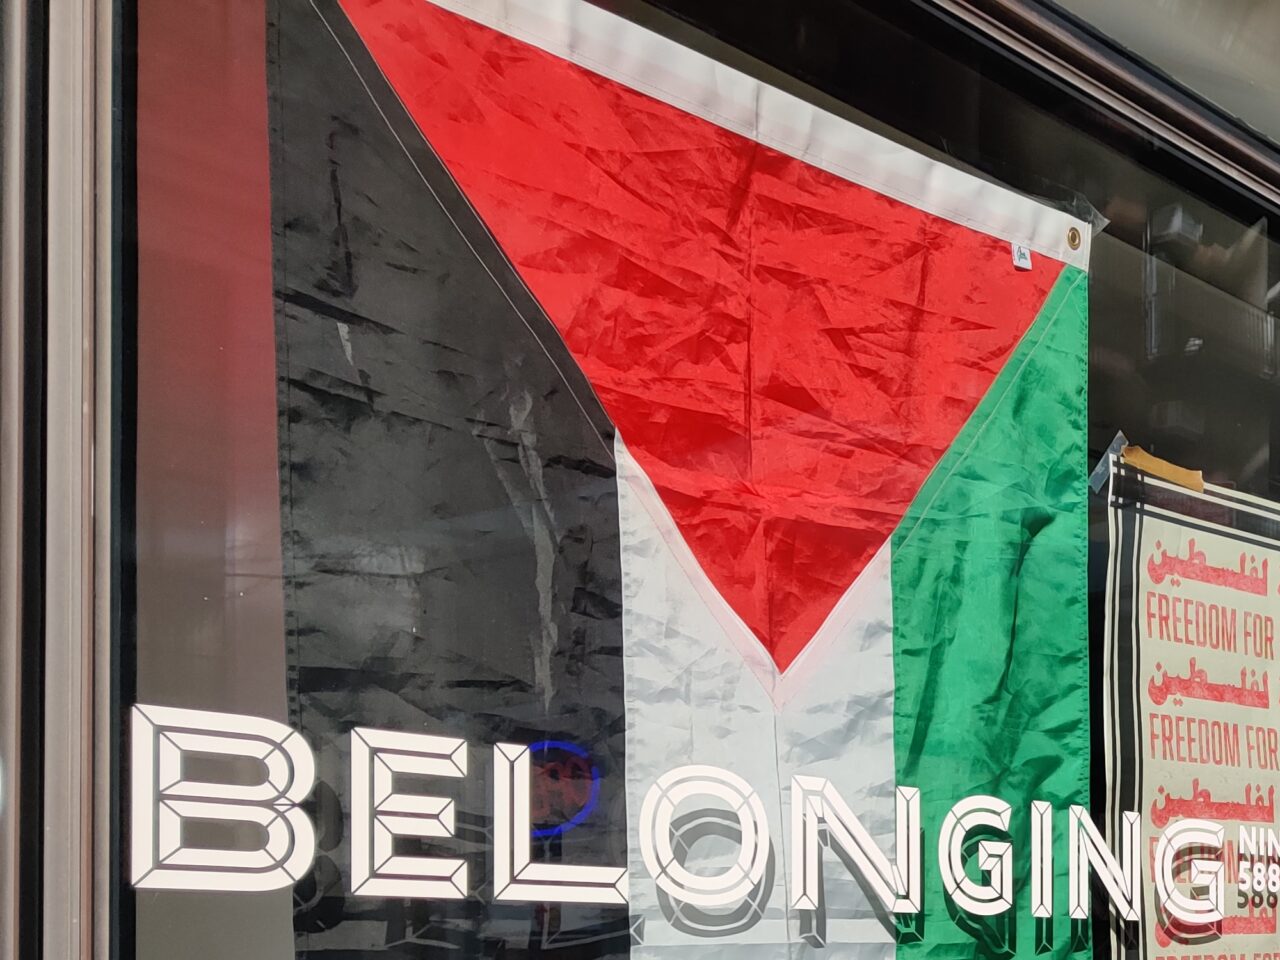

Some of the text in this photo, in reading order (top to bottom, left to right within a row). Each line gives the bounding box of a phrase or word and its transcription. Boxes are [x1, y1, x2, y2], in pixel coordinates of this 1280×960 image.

[1147, 538, 1268, 597] لفلسطين
[1146, 591, 1237, 654] FREEDOM
[1244, 611, 1275, 661] FOR
[1148, 657, 1270, 709] لفلسطين
[1149, 712, 1241, 768] FREEDOM
[1245, 725, 1280, 771] FOR
[131, 703, 1225, 925] BELONGING
